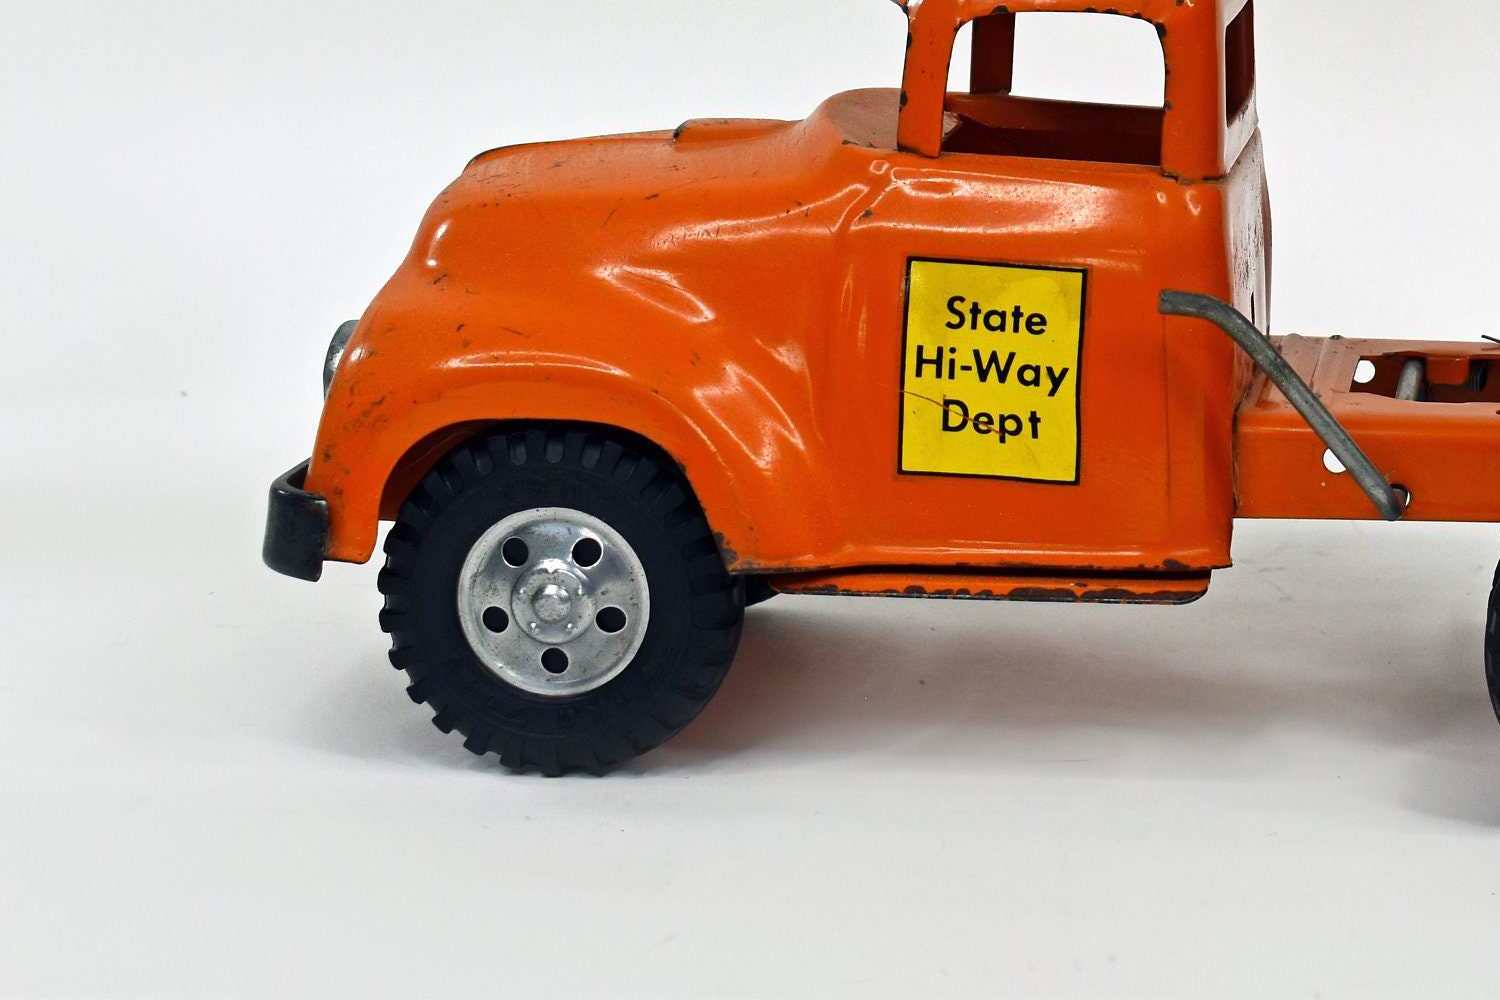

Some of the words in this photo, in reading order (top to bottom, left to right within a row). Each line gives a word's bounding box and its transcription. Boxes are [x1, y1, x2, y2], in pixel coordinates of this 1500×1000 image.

[945, 295, 1048, 336] State
[915, 344, 1070, 397] Hi-Way
[941, 398, 1042, 444] Dept
